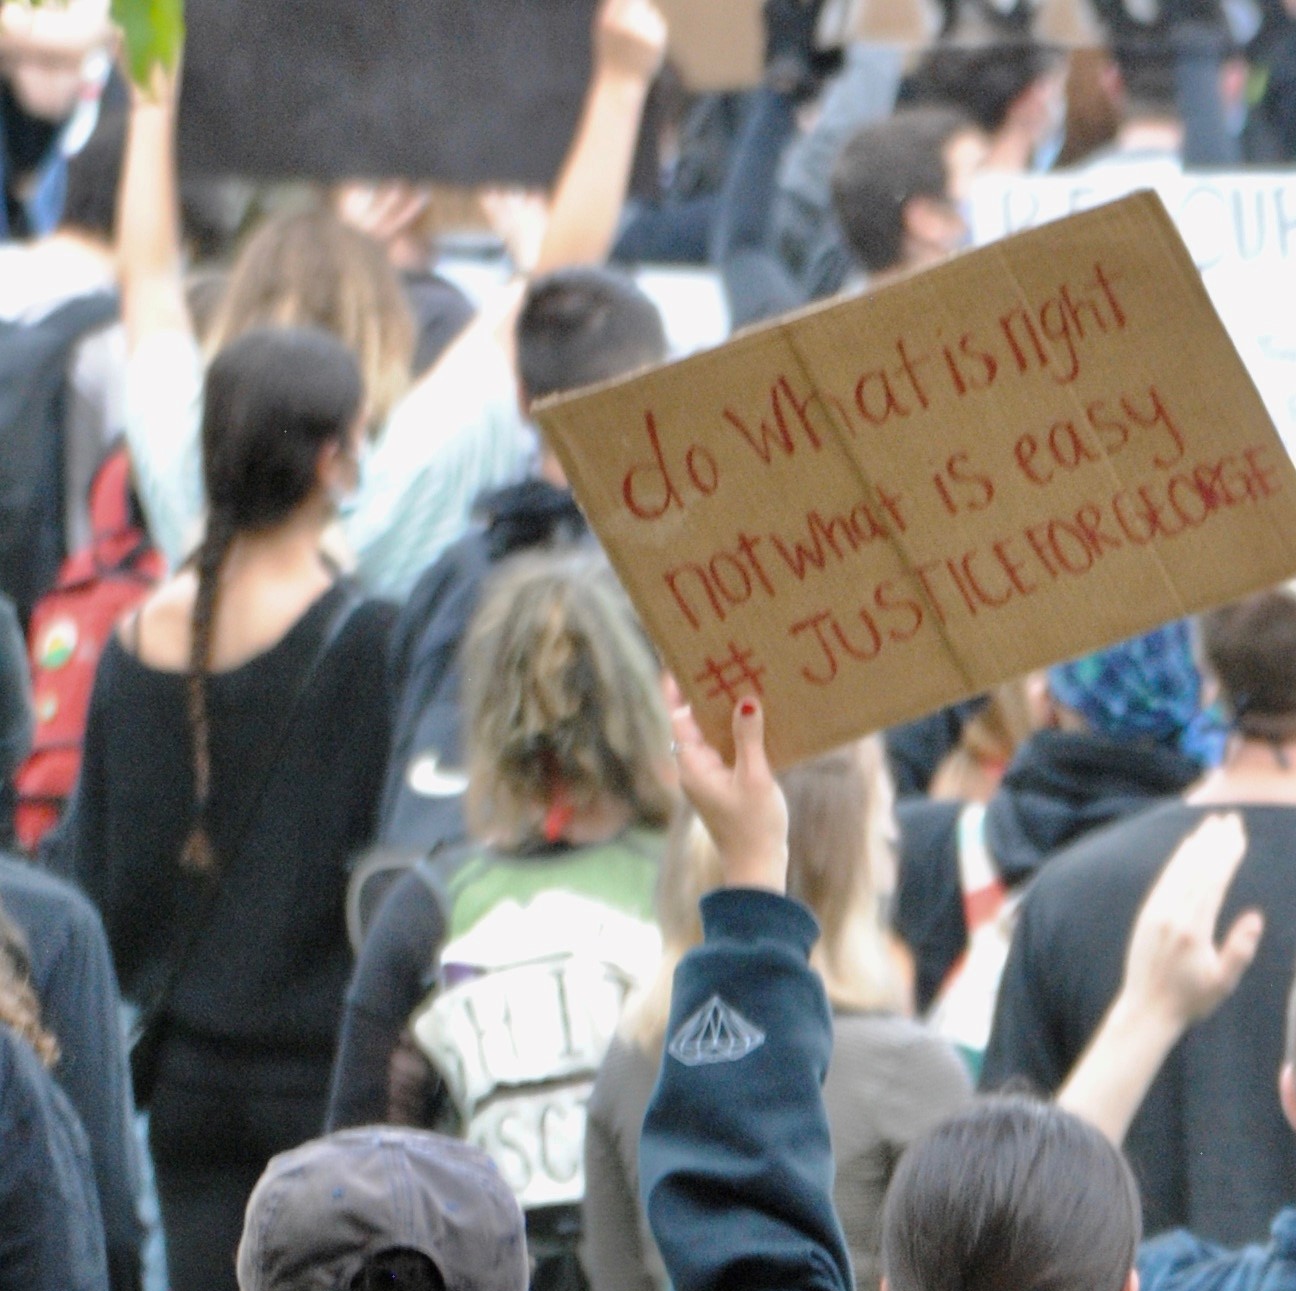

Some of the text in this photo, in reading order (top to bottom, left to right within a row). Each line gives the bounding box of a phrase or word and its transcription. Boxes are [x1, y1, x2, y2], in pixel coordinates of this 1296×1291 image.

[622, 410, 719, 520] do
[938, 330, 998, 397] is
[999, 262, 1127, 385] right
[663, 385, 1185, 630] not what is easy
